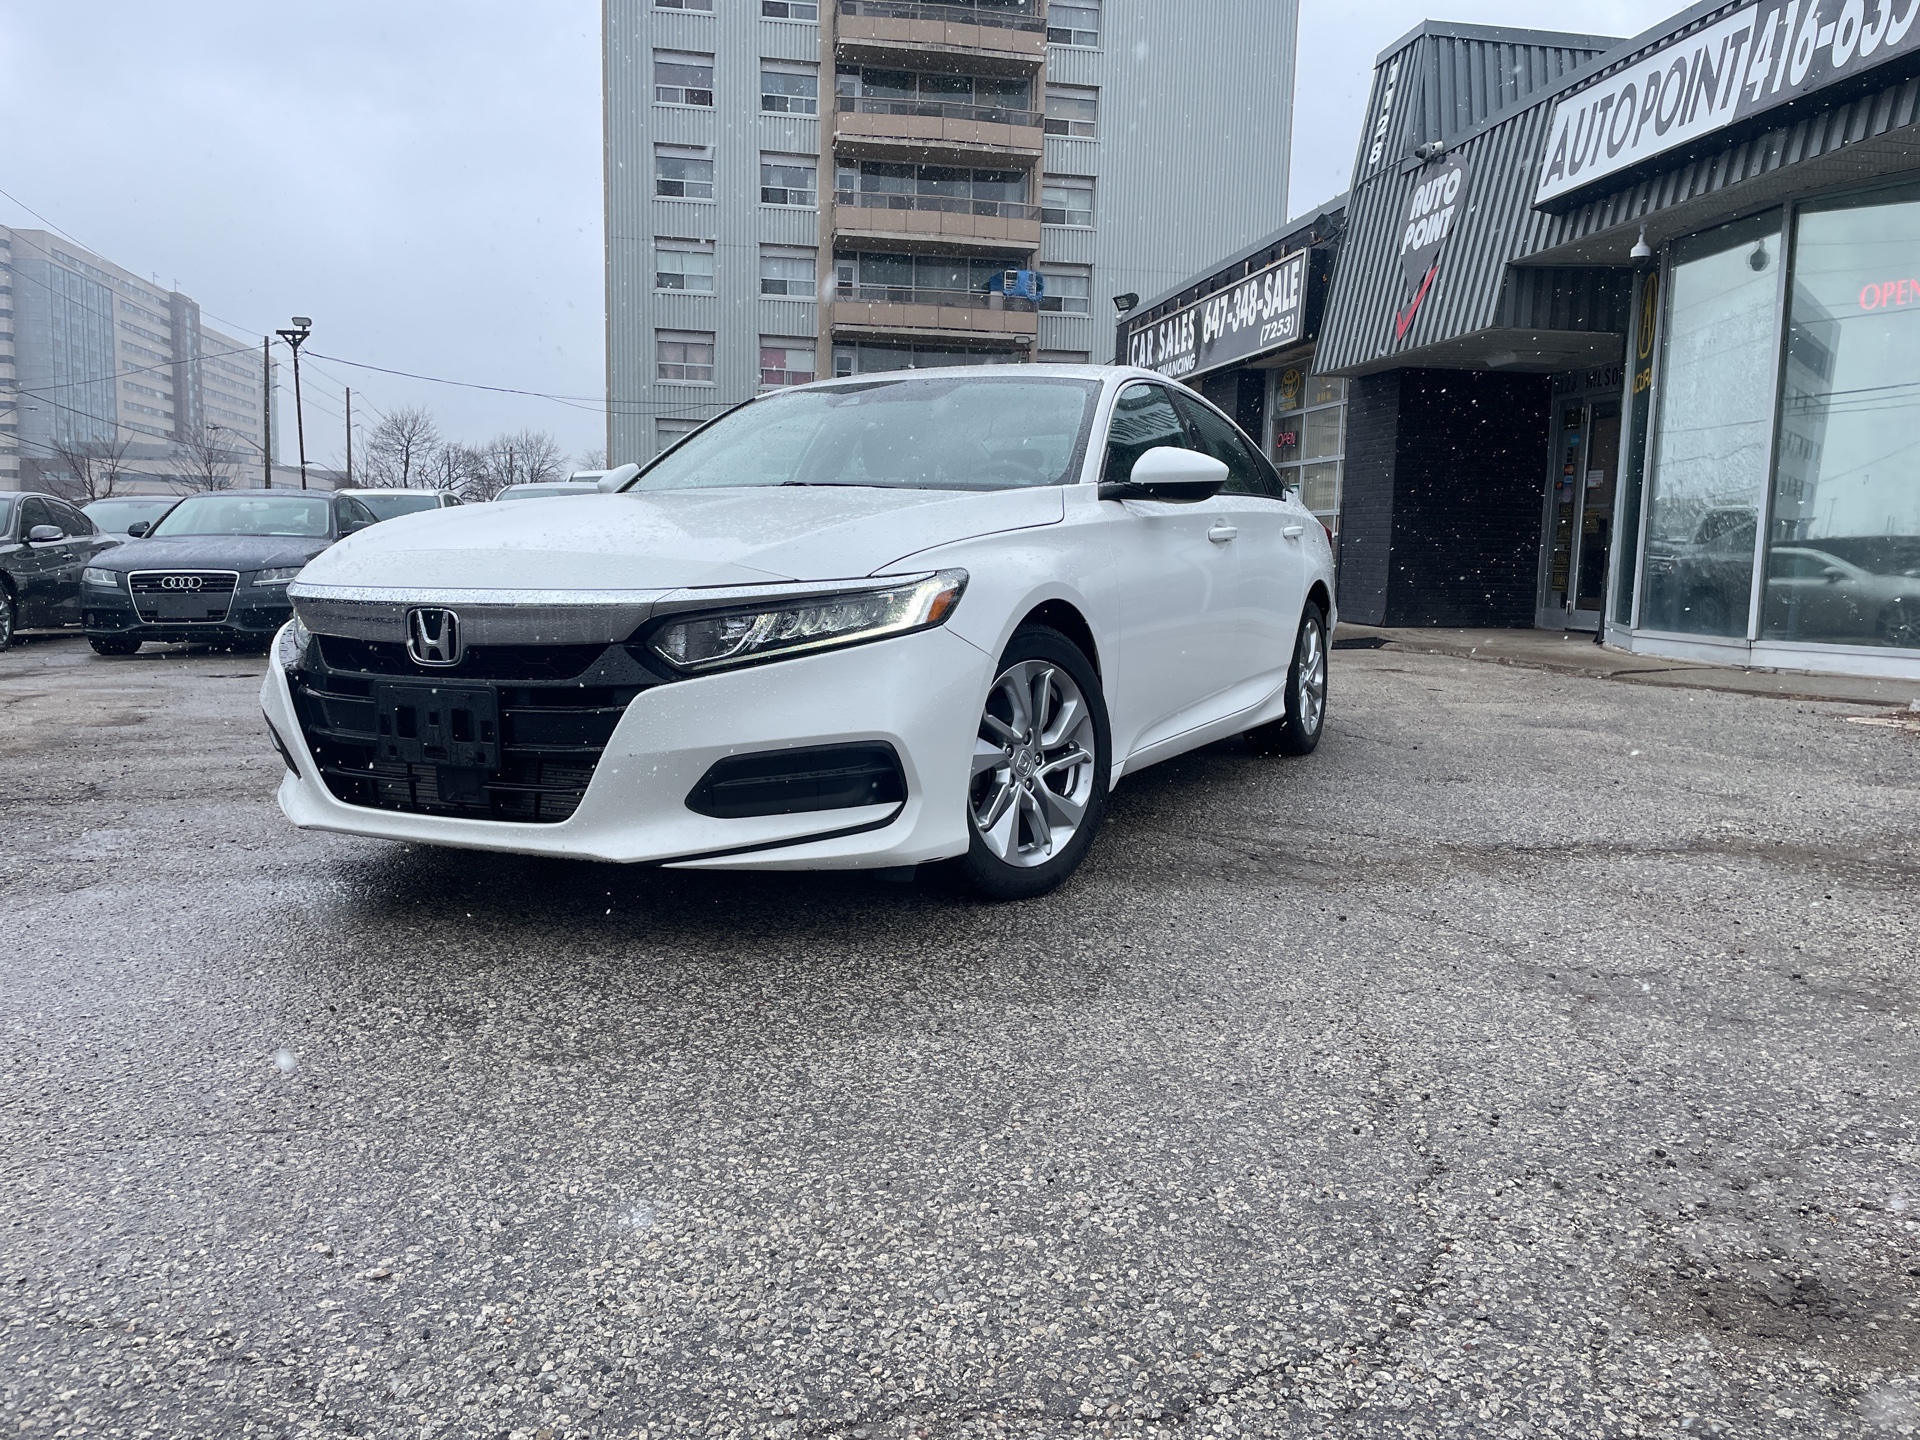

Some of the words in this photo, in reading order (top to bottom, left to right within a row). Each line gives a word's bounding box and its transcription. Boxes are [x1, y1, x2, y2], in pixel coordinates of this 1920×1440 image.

[1368, 61, 1399, 165] 1128
[1409, 167, 1462, 221] AUTO
[1401, 204, 1455, 256] POINT
[1203, 259, 1300, 344] 647-348-SALE
[1131, 329, 1154, 368] CAR
[1158, 309, 1195, 362] SALES
[1259, 313, 1295, 346] (7253)
[1585, 366, 1622, 389] WILSO
